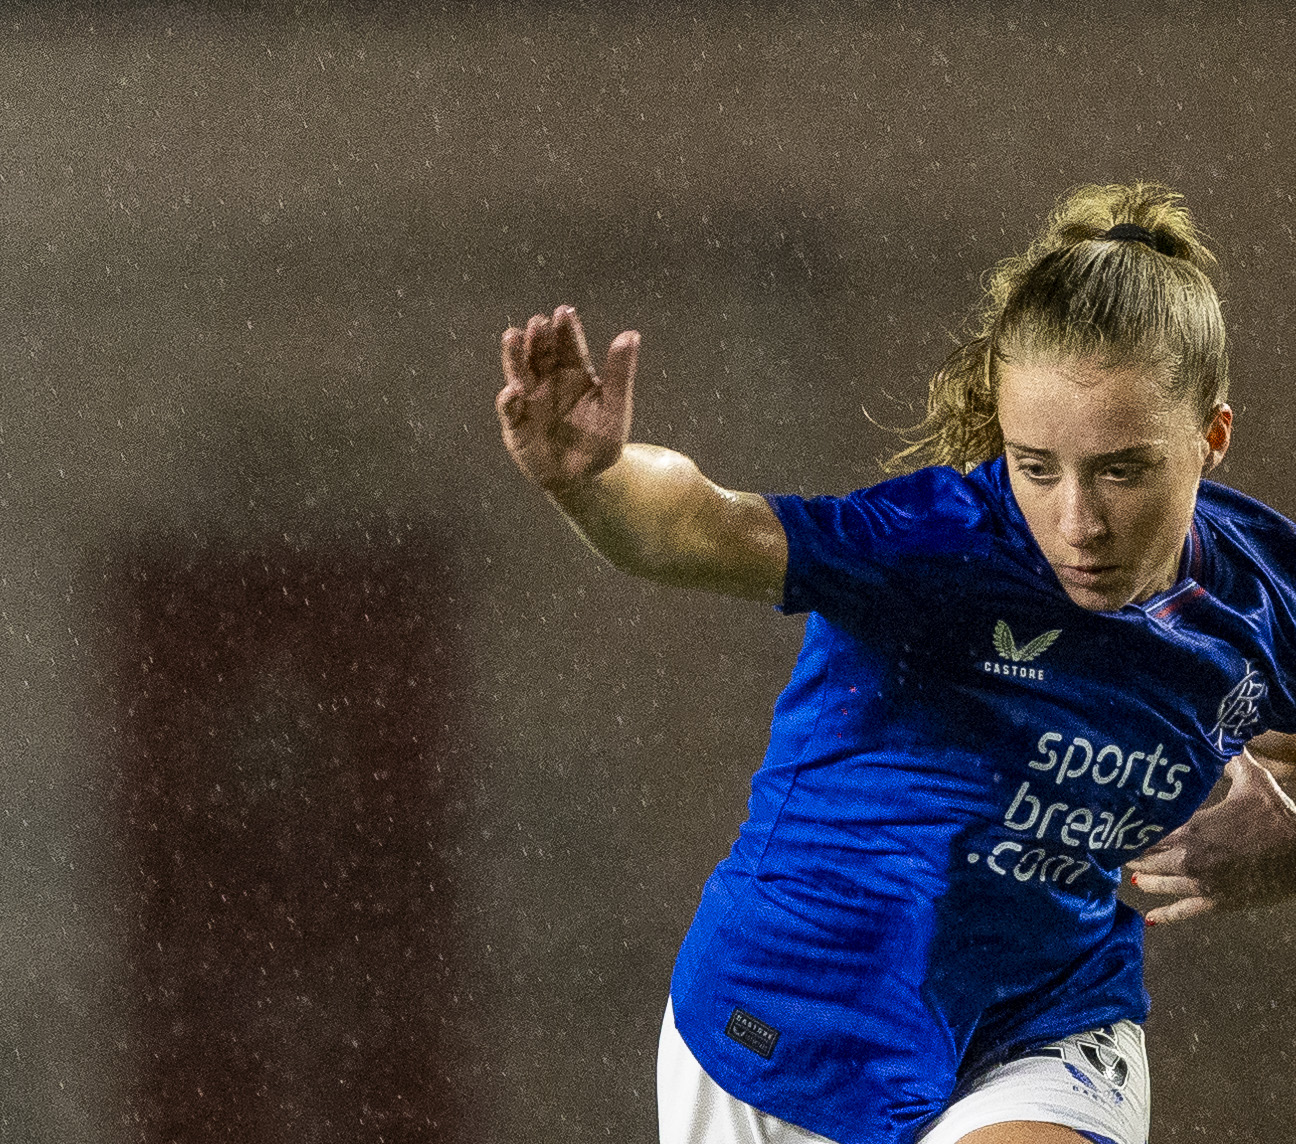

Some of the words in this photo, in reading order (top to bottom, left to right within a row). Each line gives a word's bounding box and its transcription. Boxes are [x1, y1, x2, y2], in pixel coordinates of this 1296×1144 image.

[984, 661, 1045, 681] CASTORE
[1028, 731, 1190, 800] sports
[1003, 781, 1164, 850] breaks
[967, 841, 1090, 884] .com
